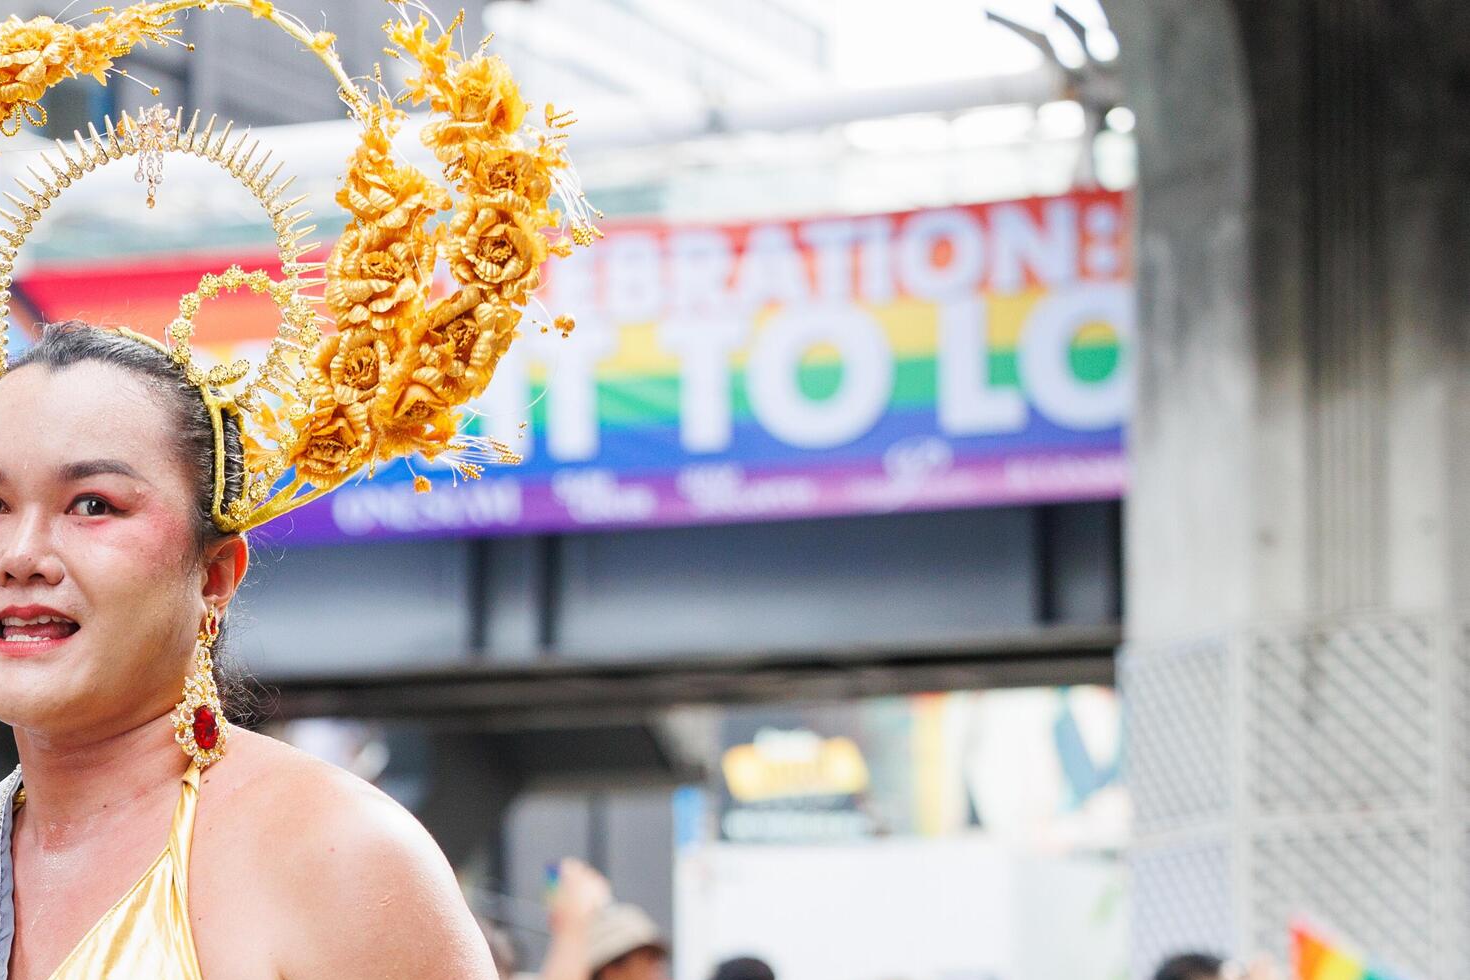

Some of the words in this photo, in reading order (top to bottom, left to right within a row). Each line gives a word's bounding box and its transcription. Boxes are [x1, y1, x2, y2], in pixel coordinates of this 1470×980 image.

[548, 200, 1120, 318] EBRATION:
[657, 300, 893, 453] TO
[935, 288, 1134, 436] LO
